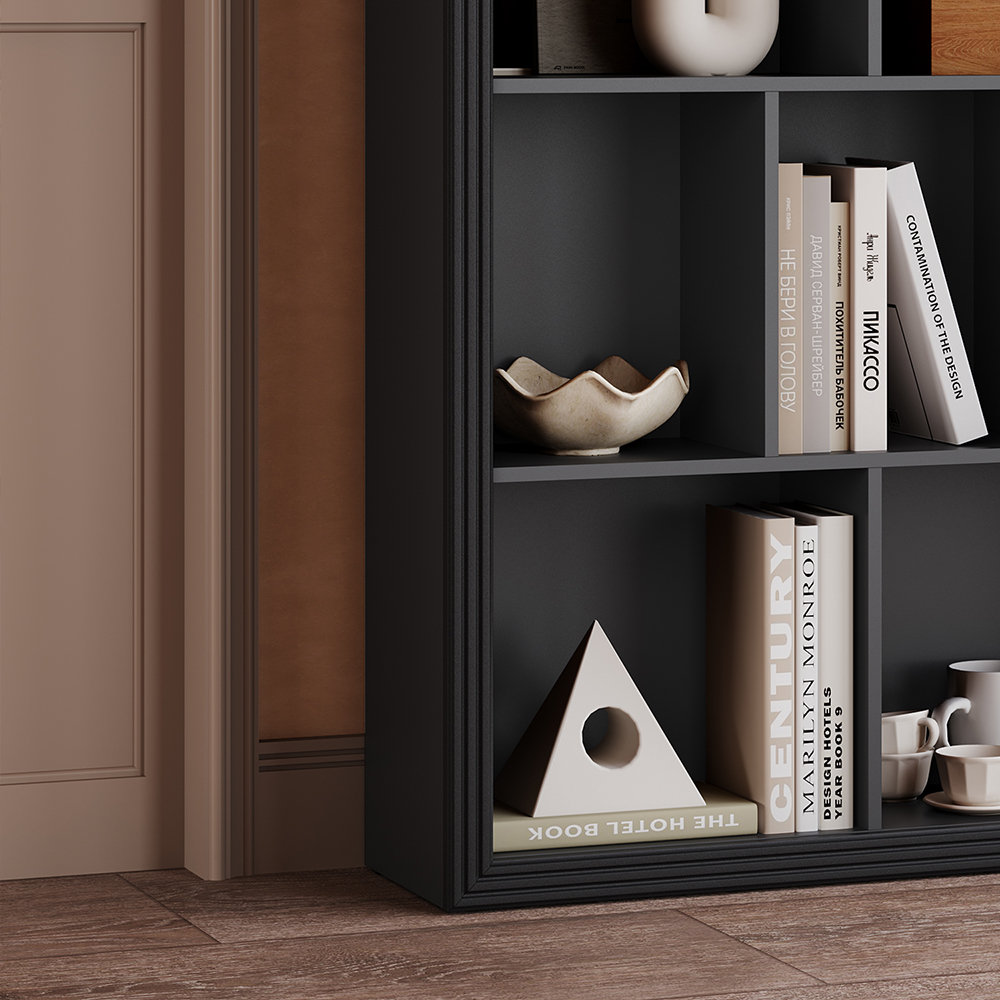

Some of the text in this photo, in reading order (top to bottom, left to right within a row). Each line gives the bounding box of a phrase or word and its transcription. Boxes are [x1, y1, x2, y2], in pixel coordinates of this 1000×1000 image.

[780, 249, 796, 413] НЕ БЕРИ В ГОЛОВУ
[810, 234, 824, 397] ДАВИД СЕРВАН-ШРЕЙБЕР
[836, 301, 844, 430] ПОХИТИТЕЛЬ БАБОЧЕК
[863, 311, 880, 392] ПИКАССО
[906, 214, 964, 400] CONTAMINATION OF THE DESIGN
[770, 534, 793, 823] CENTURY
[802, 538, 815, 815] MARILYN MONROE
[824, 686, 832, 820] DESIGN HOTELS
[834, 706, 843, 820] YEAR BOOK 9
[528, 814, 739, 841] THE HOTEL BOOK
